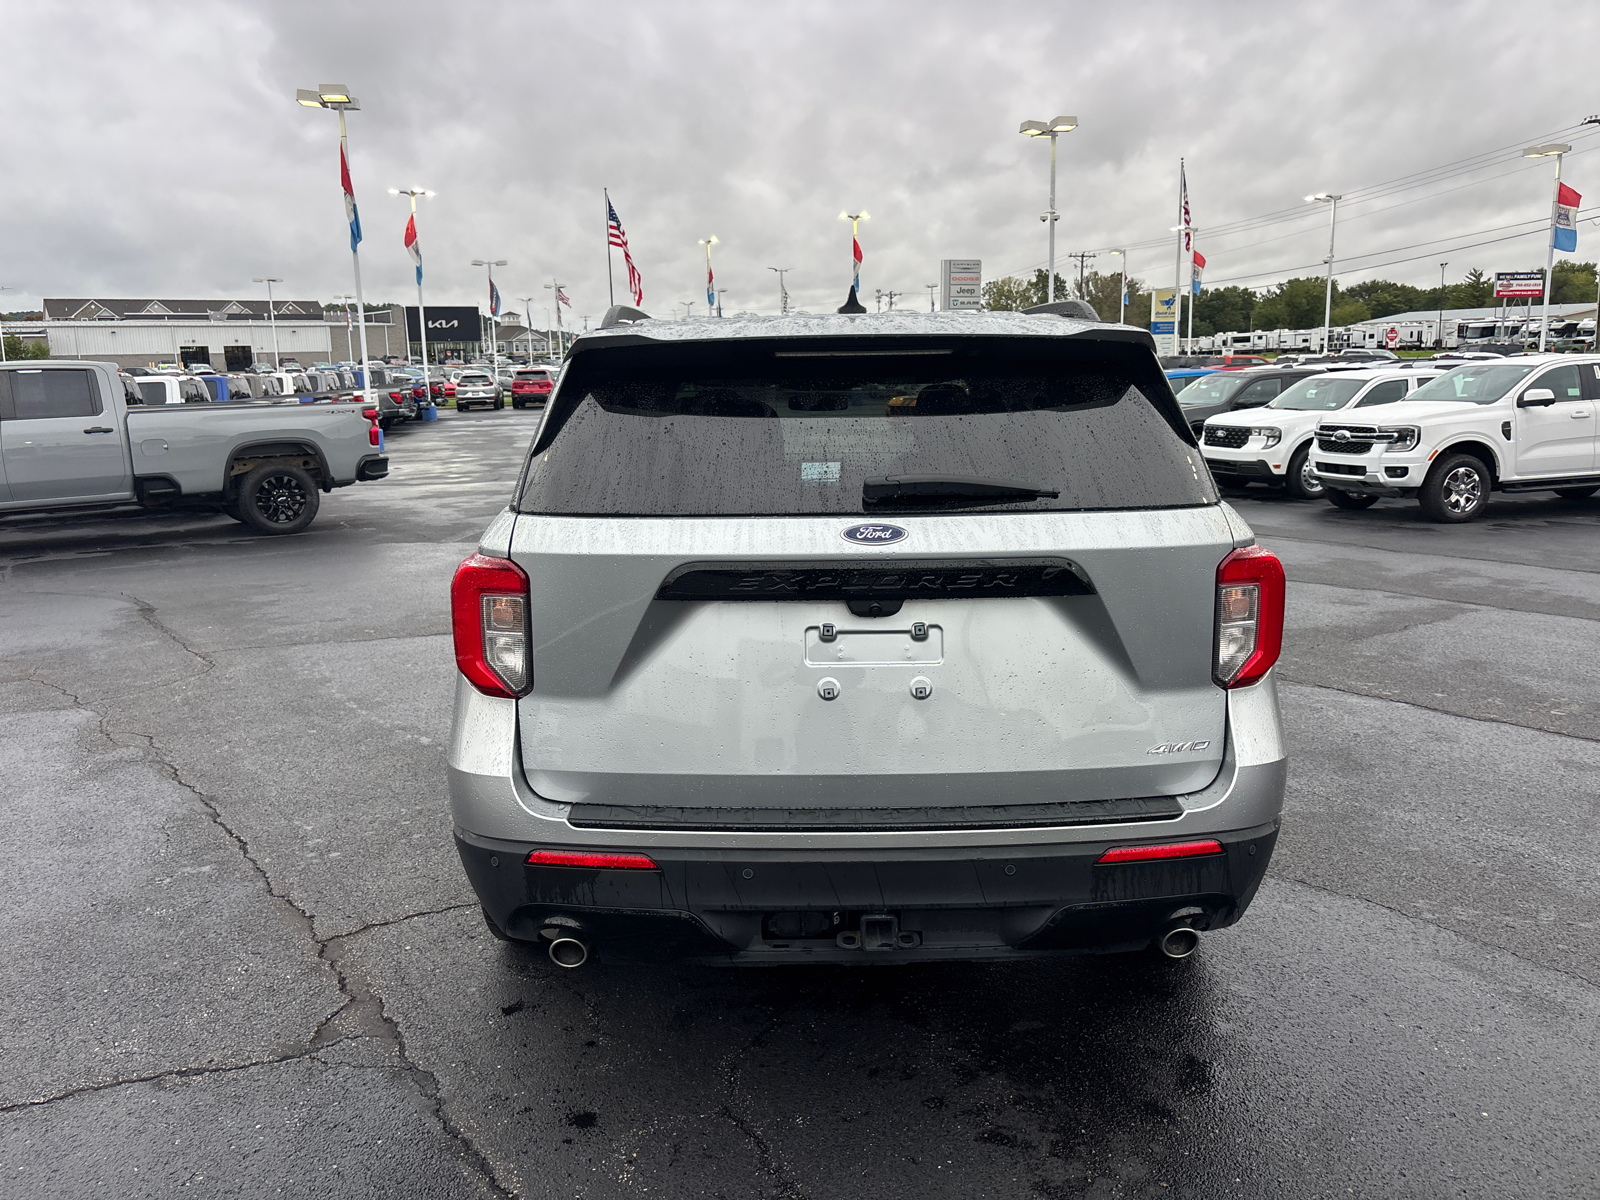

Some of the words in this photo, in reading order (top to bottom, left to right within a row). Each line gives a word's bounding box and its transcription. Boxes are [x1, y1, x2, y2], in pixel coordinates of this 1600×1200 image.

[956, 287, 975, 295] Jeep
[427, 319, 459, 329] KIA
[856, 526, 893, 539] Ford
[729, 574, 1018, 590] EXPLORER
[1147, 740, 1211, 754] 4WD
